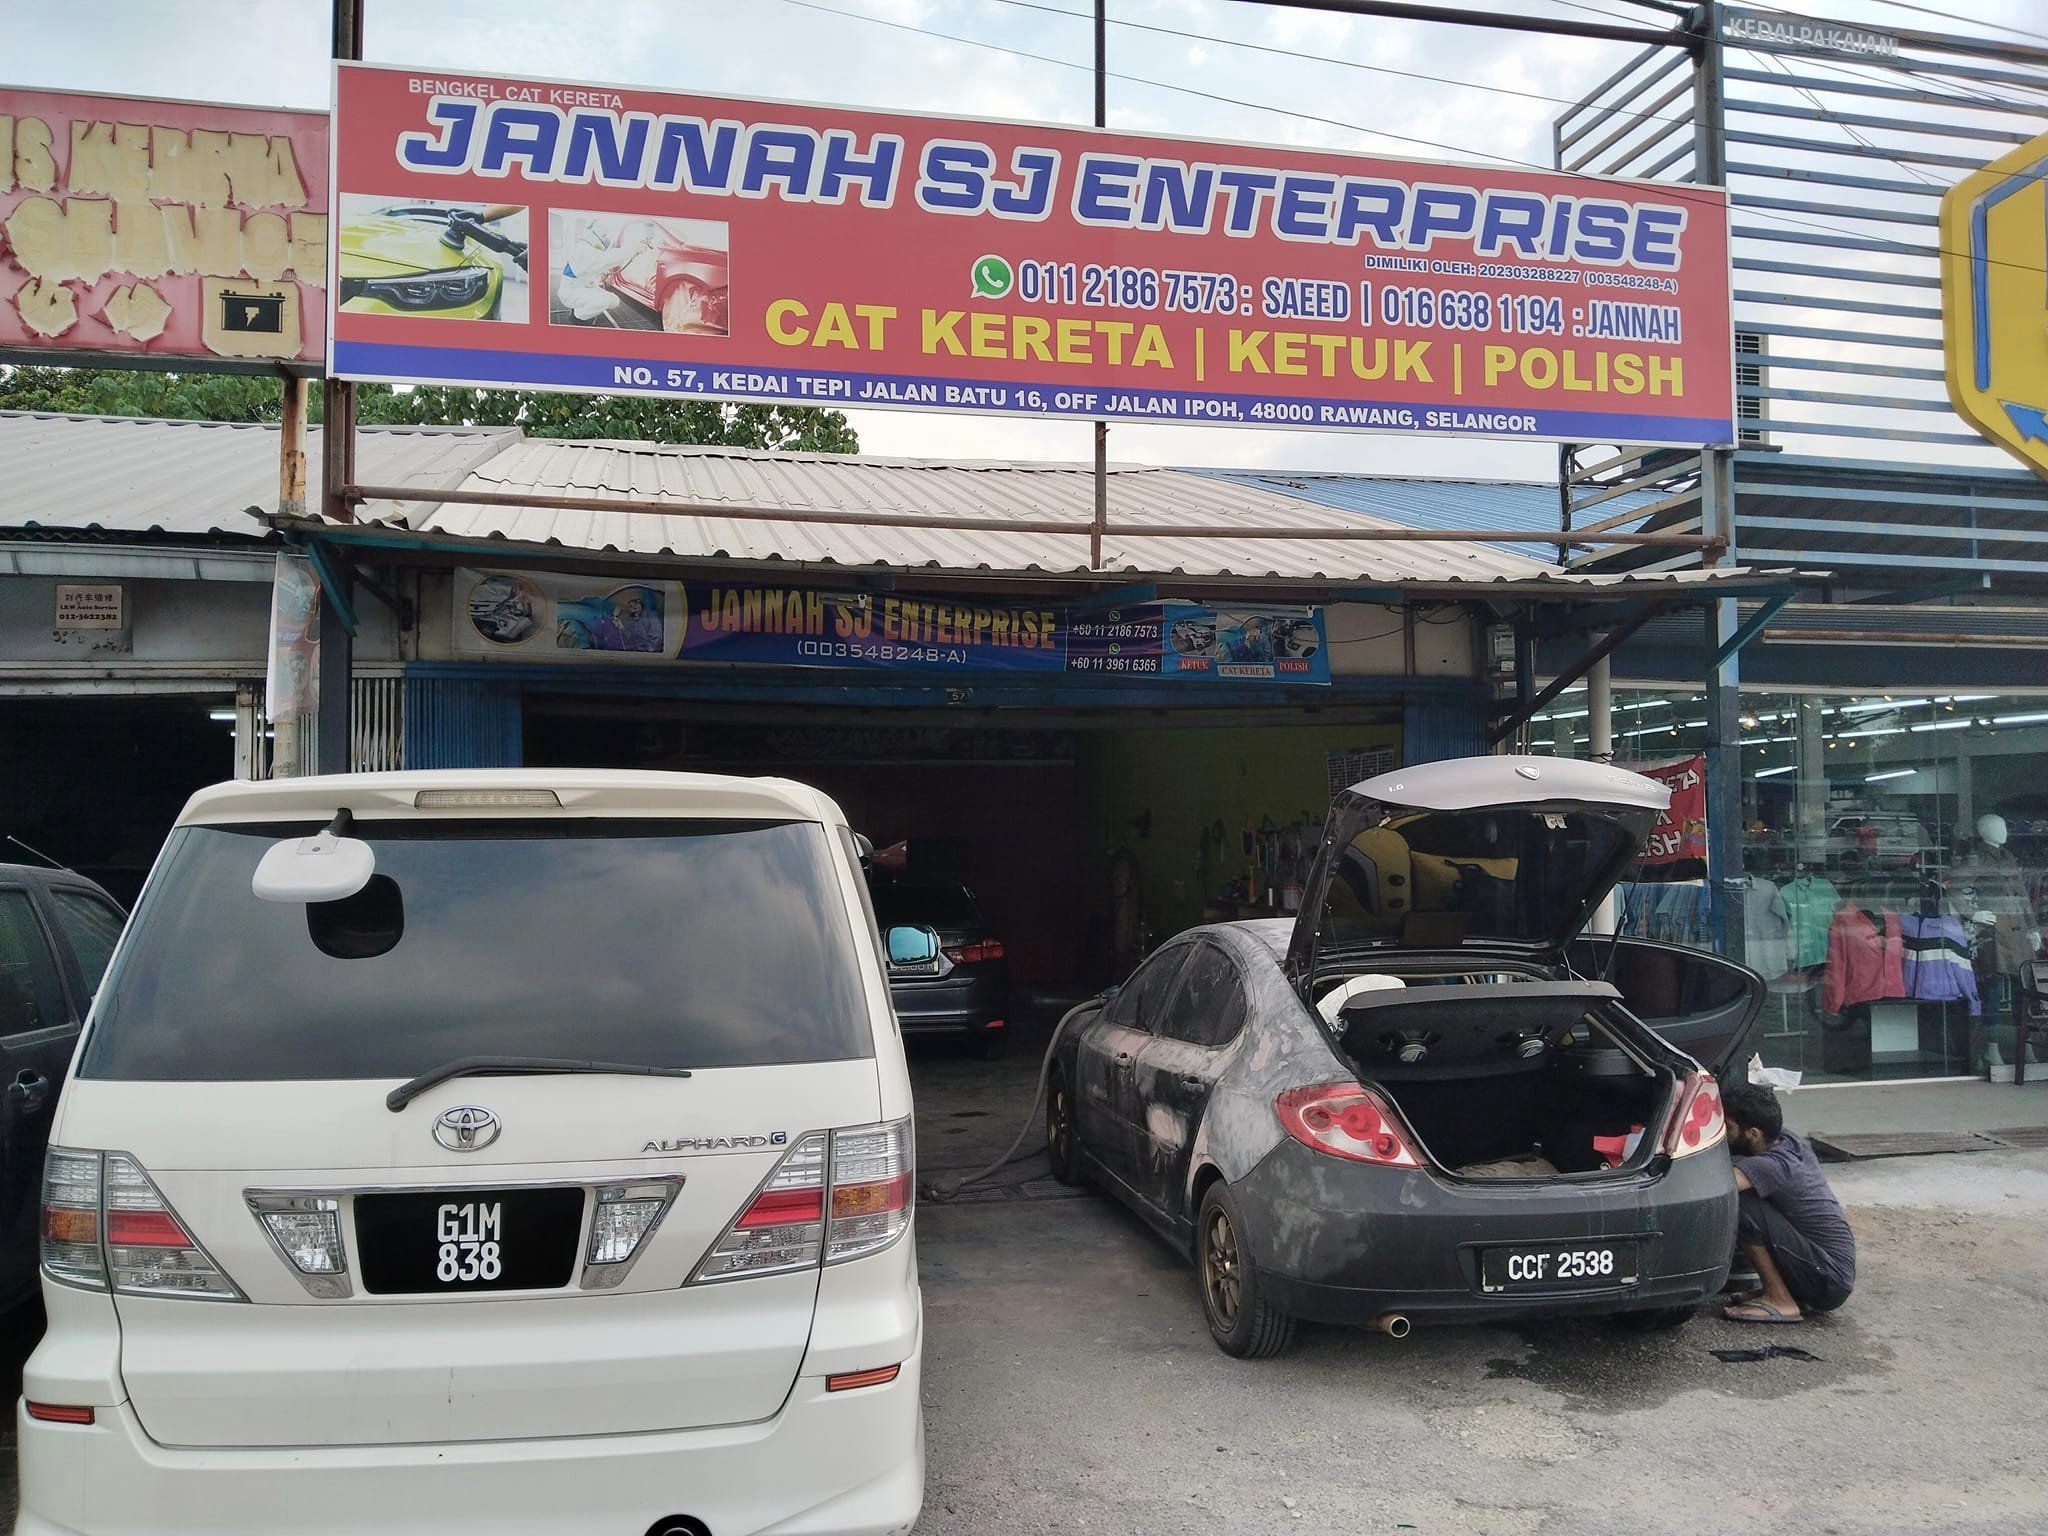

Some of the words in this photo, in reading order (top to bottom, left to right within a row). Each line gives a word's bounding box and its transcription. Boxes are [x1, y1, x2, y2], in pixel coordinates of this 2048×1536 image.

[1729, 18, 1794, 44] KEDAI
[1799, 26, 1898, 57] PAKAIAN
[409, 78, 502, 102] BENGKEL
[505, 85, 543, 104] CAT
[549, 89, 624, 110] KERETA
[398, 97, 902, 207] JANNAH
[917, 139, 1059, 220] SJ
[1073, 154, 1686, 270] ENTERPRISE
[1365, 255, 1428, 273] DIMILIKI
[1431, 259, 1476, 277] OLEH:
[1479, 263, 1580, 284] 202303288227
[1584, 271, 1679, 294] (003548248-A)
[1019, 260, 1077, 303] 011
[1084, 265, 1158, 309] 2186
[1263, 279, 1350, 319] SAEED
[1382, 286, 1434, 326] 016
[1440, 290, 1491, 331] 638
[1500, 296, 1563, 336] 1194
[765, 298, 897, 350] CAT
[921, 308, 1174, 369] KERETA
[1228, 329, 1435, 383] KETUK
[1484, 345, 1684, 397] POLISH
[613, 366, 659, 387] NO.
[667, 369, 704, 393] 57,
[712, 372, 788, 395] KEDAI
[796, 377, 851, 398] TEPI
[860, 380, 938, 403] JALAN
[946, 384, 1006, 408] BATU
[1015, 390, 1047, 413] 16,
[1055, 392, 1097, 412] OFF
[1104, 394, 1177, 416] JALAN
[1184, 398, 1244, 422] IPOH,
[1250, 402, 1314, 422] 48000
[1320, 405, 1420, 430] RAWANG,
[1425, 410, 1537, 432] SELANGOR
[700, 588, 824, 635] JANNAH
[834, 595, 873, 639] SJ
[883, 598, 1057, 649] ENTERPRISE
[1073, 624, 1091, 636] +60
[1095, 625, 1105, 637] 11
[1107, 625, 1132, 637] 2186
[1134, 625, 1158, 638] 7573
[796, 640, 967, 664] (003548248-A)
[1071, 657, 1089, 669] +60
[1092, 658, 1103, 670] 11
[1106, 658, 1129, 670] 3961
[1132, 659, 1156, 671] 6365
[1181, 660, 1209, 670] KETUK
[1280, 661, 1309, 672] POLISH
[1221, 666, 1237, 675] CAT
[1239, 667, 1271, 676] KERETA
[952, 692, 965, 701] 57
[642, 1135, 768, 1152] ALPHARD
[437, 1203, 501, 1242] G1M
[437, 1242, 501, 1282] 838
[1557, 1250, 1613, 1277] 2538
